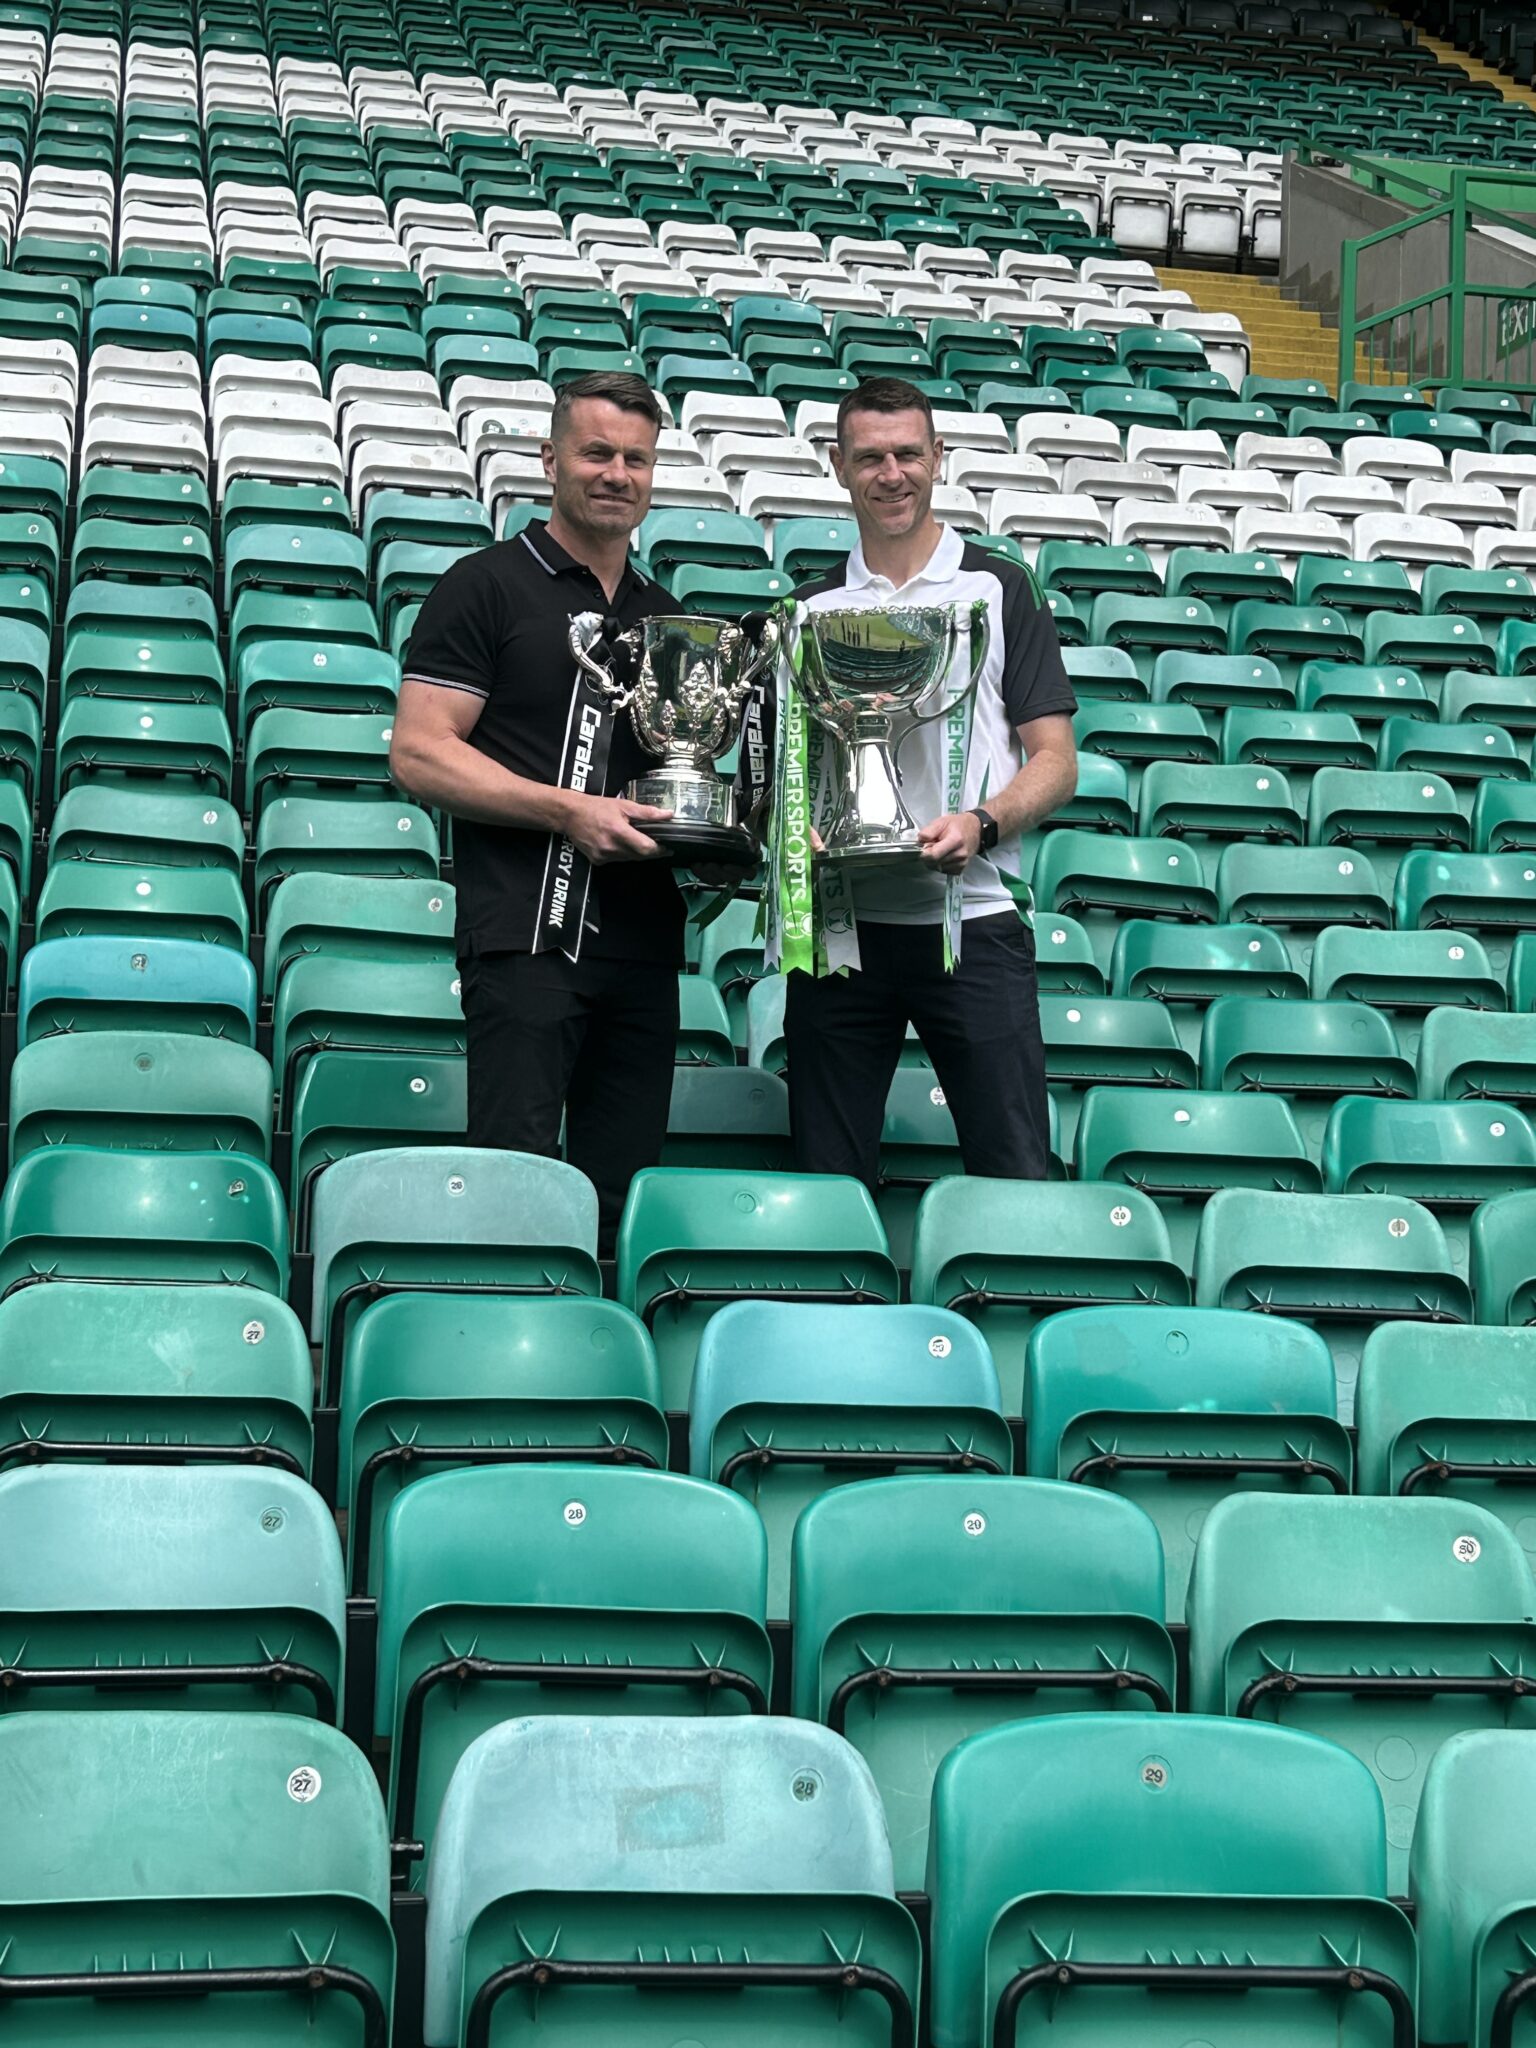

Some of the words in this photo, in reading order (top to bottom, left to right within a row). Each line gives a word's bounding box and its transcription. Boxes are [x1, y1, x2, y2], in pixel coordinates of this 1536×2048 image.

[570, 703, 602, 793] Caraba
[747, 685, 769, 784] Carabao
[548, 876, 570, 929] DRINK
